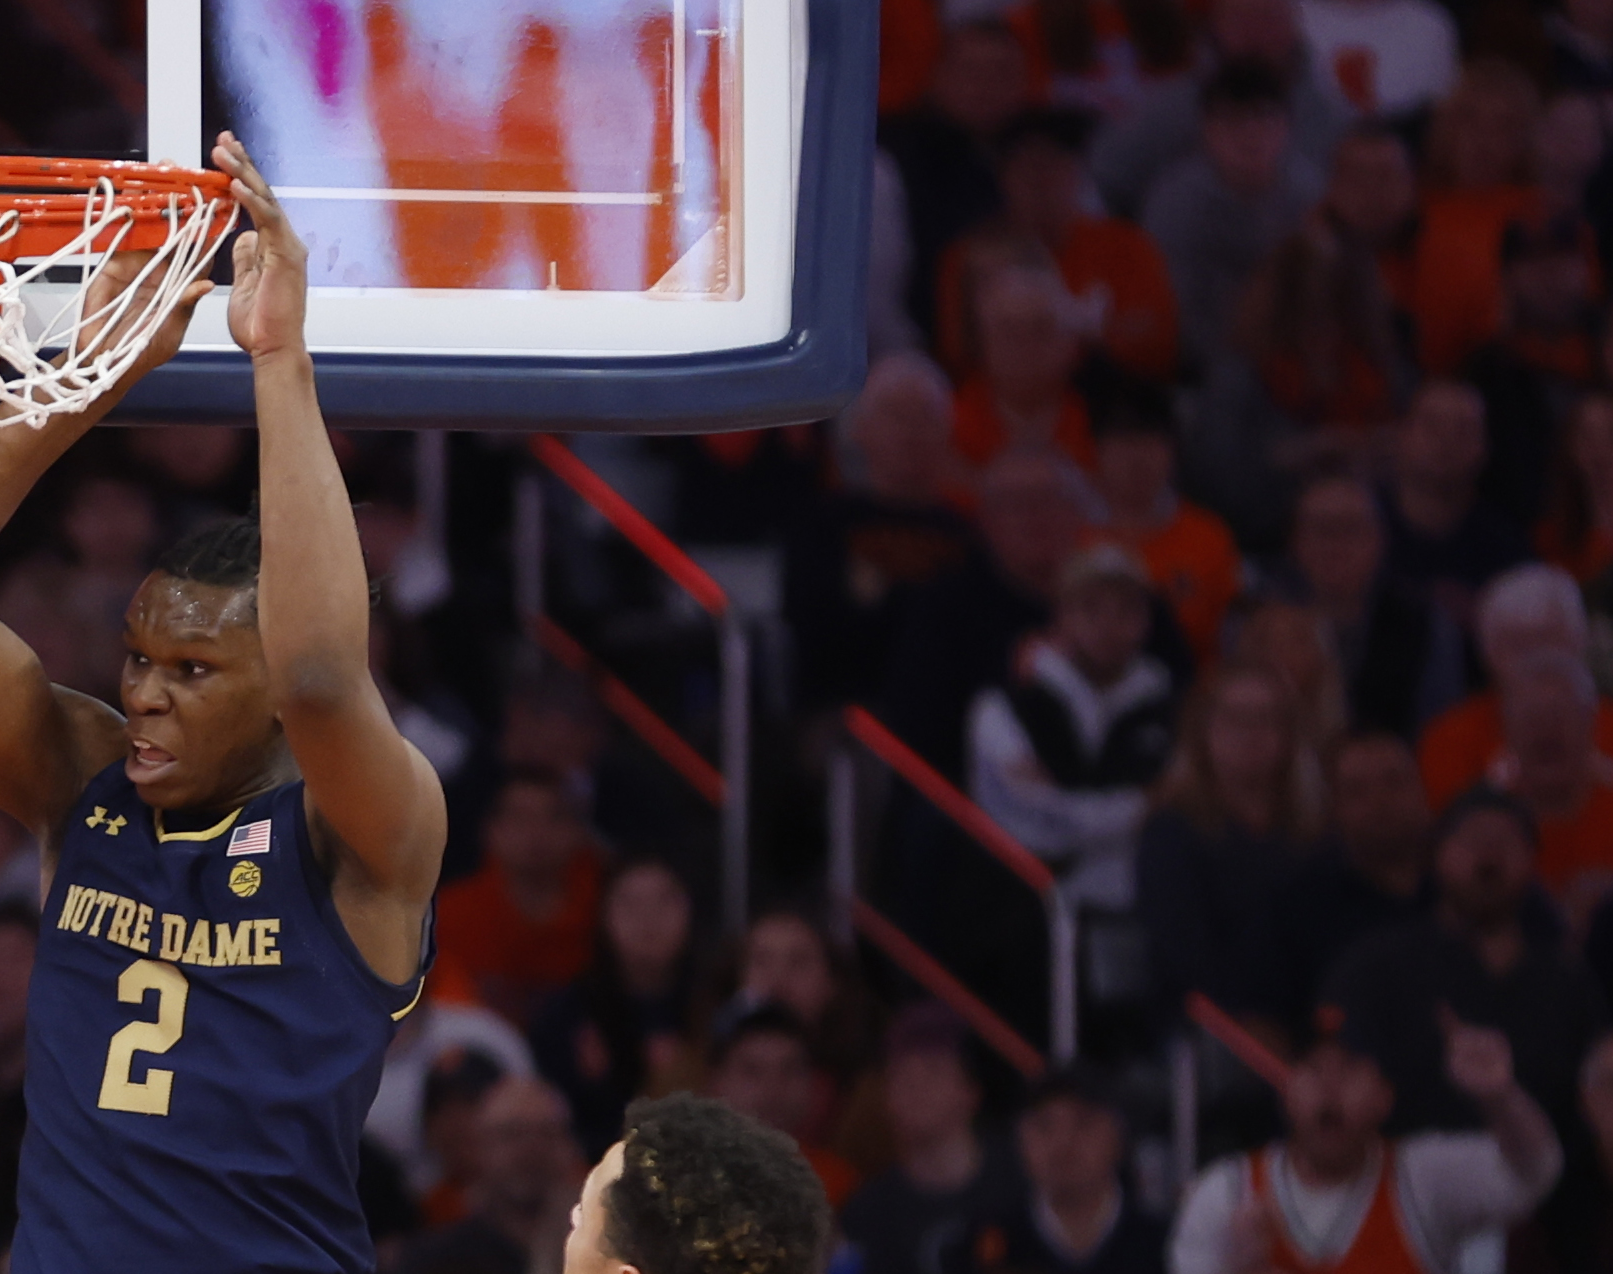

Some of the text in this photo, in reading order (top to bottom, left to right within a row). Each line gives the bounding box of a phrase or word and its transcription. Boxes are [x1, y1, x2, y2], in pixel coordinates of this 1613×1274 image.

[56, 883, 282, 968] NOTRE DAME
[97, 957, 190, 1117] 2
